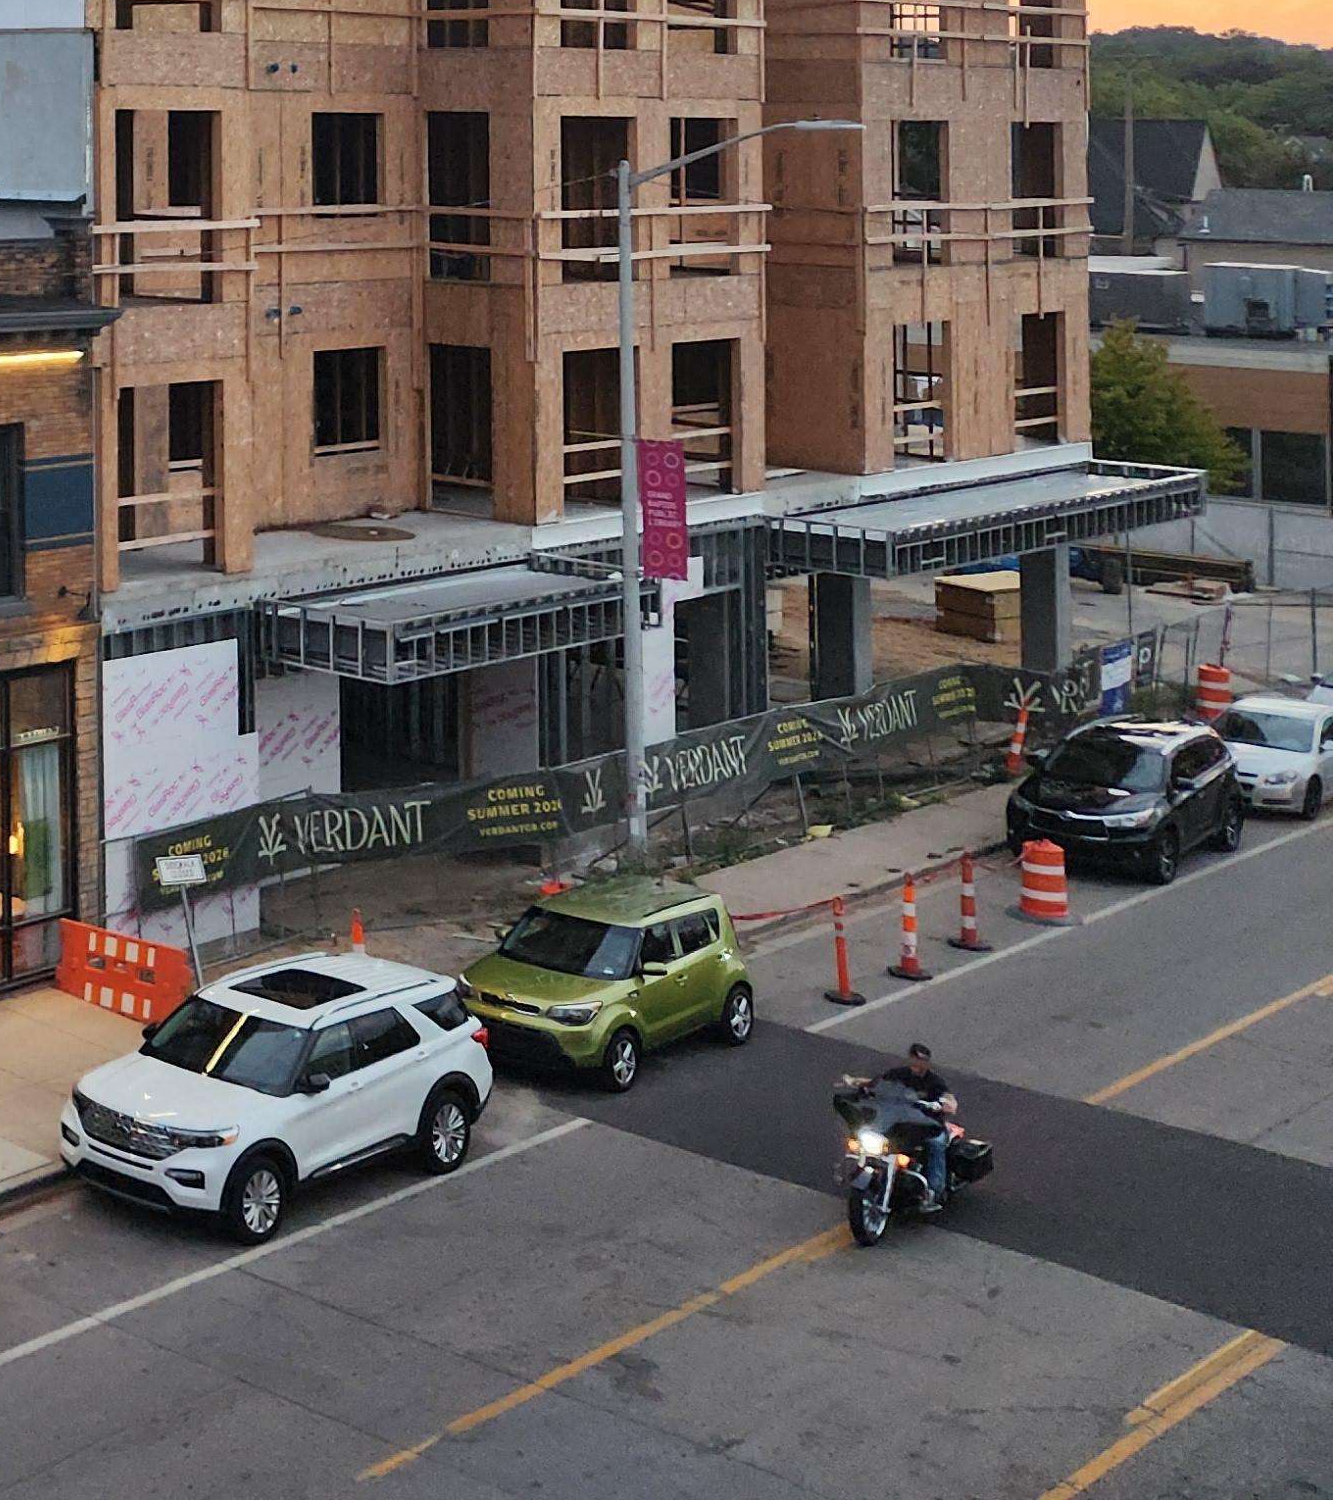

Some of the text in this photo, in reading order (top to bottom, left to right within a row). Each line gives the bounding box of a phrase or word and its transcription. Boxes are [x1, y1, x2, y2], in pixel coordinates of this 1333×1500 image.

[665, 735, 747, 793] VERDANT
[487, 784, 545, 802] COMING
[467, 803, 530, 821] SUMMER
[293, 800, 432, 855] VERDANT
[168, 835, 213, 857] COMING
